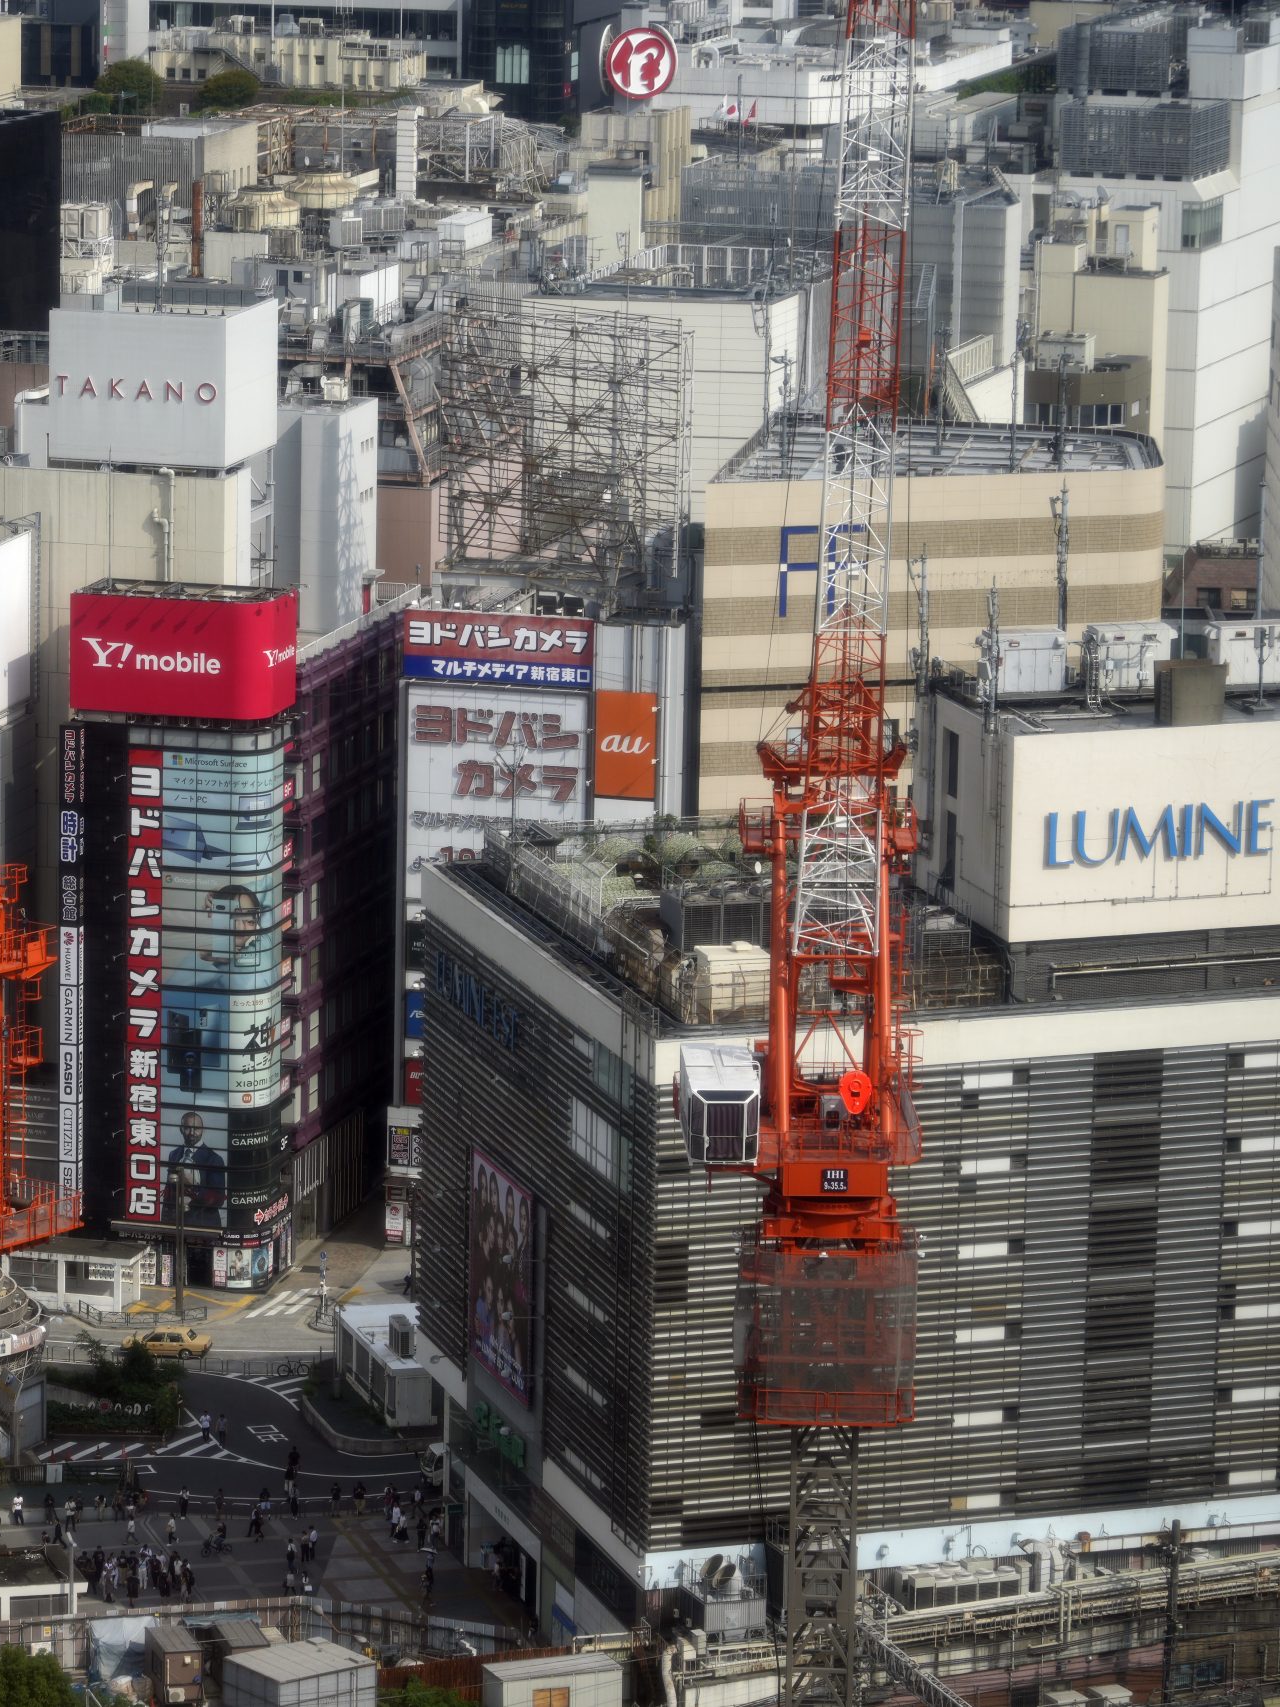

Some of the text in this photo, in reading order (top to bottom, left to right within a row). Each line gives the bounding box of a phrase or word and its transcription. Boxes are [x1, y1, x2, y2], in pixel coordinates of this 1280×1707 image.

[56, 373, 218, 404] TAKANO
[409, 620, 589, 654] ヨドバシカメラ
[530, 665, 591, 683] 新宿東口
[414, 704, 580, 750] ヨドバシ
[600, 734, 651, 755] au
[64, 729, 76, 803] ヨドバシカメラ
[184, 757, 248, 768] Microsoft Surface
[456, 760, 579, 802] カメラ
[61, 810, 78, 863] 時計
[62, 876, 78, 922] 総合館
[64, 947, 72, 981] HUAWEI
[64, 987, 73, 1042] GARMIN
[63, 1051, 73, 1096] CASIO
[63, 1108, 73, 1157] CITIZEN
[231, 1135, 269, 1147] GARMIN
[280, 1135, 289, 1151] 3F
[827, 1170, 844, 1179] IHI
[231, 1194, 268, 1205] GARMIN
